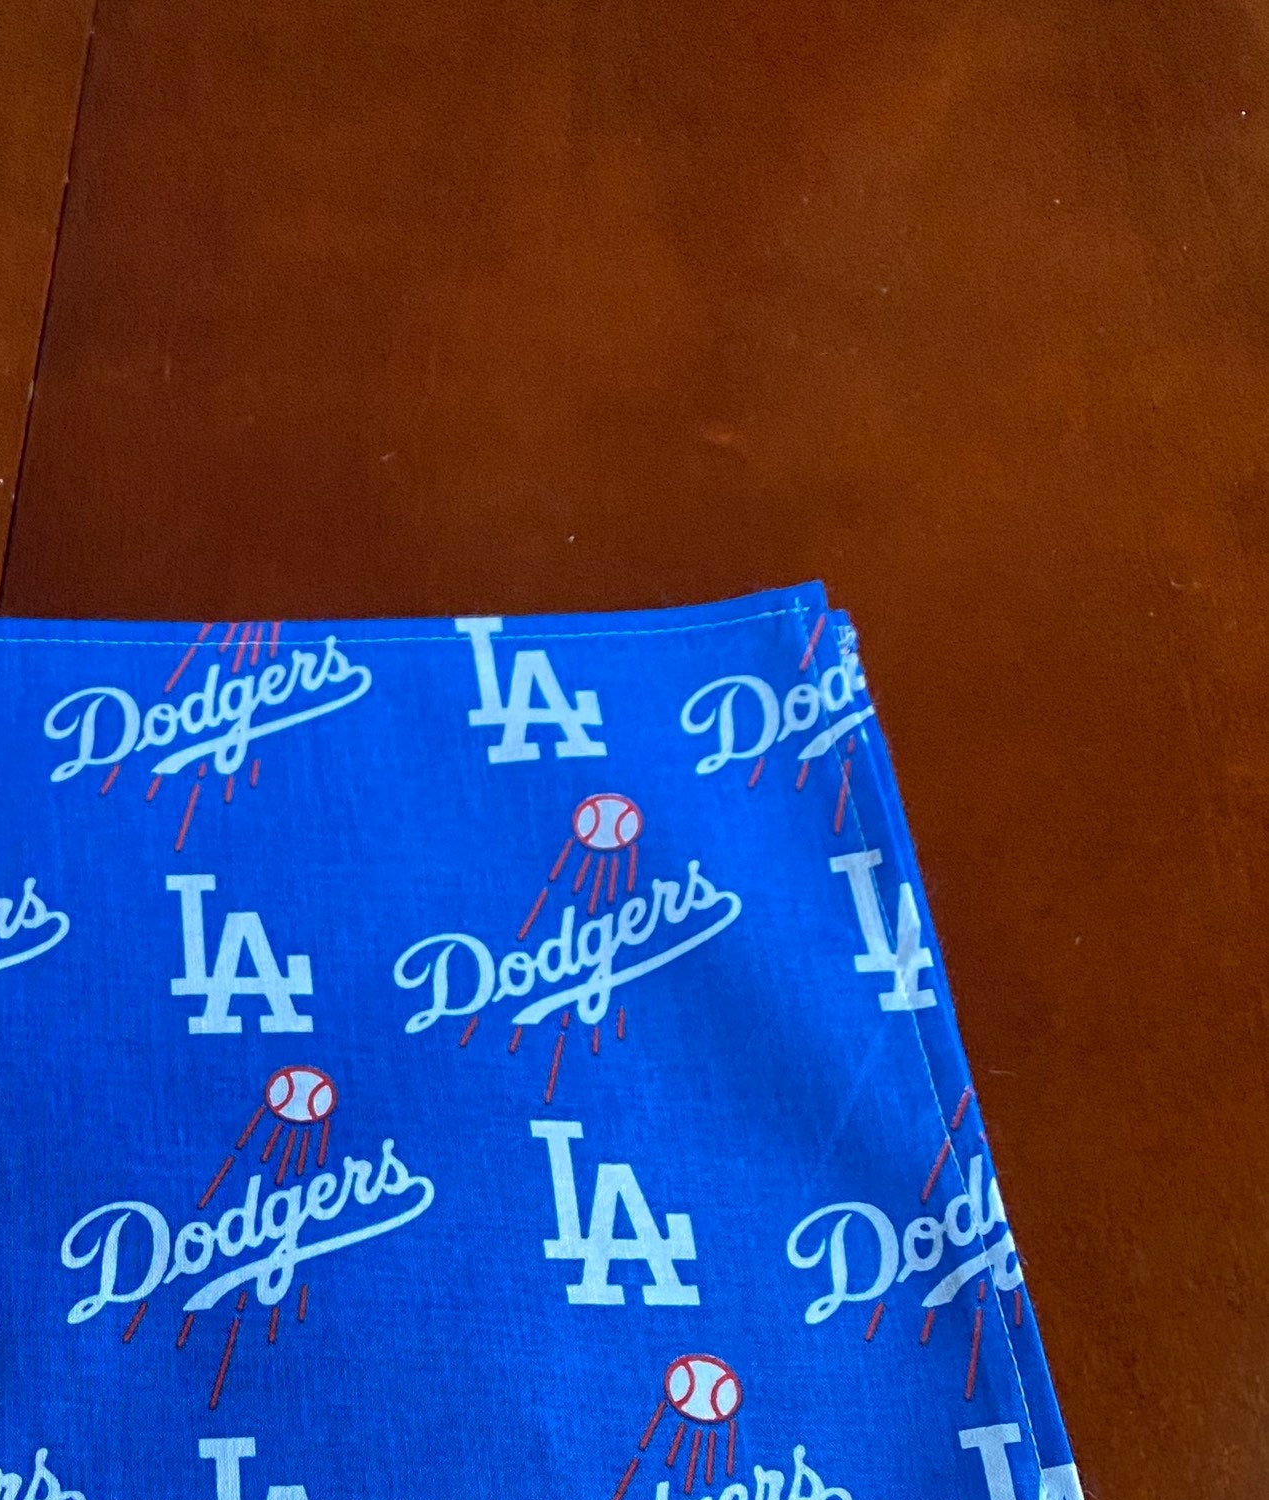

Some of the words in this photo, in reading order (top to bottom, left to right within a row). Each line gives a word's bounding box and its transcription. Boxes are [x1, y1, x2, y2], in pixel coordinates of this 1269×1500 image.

[45, 635, 372, 782] Dodgers
[454, 616, 607, 763] LA
[166, 874, 314, 1035] LA
[394, 860, 742, 1034] Dodgers
[61, 1139, 436, 1324] Dodgers
[530, 1120, 700, 1306] LA
